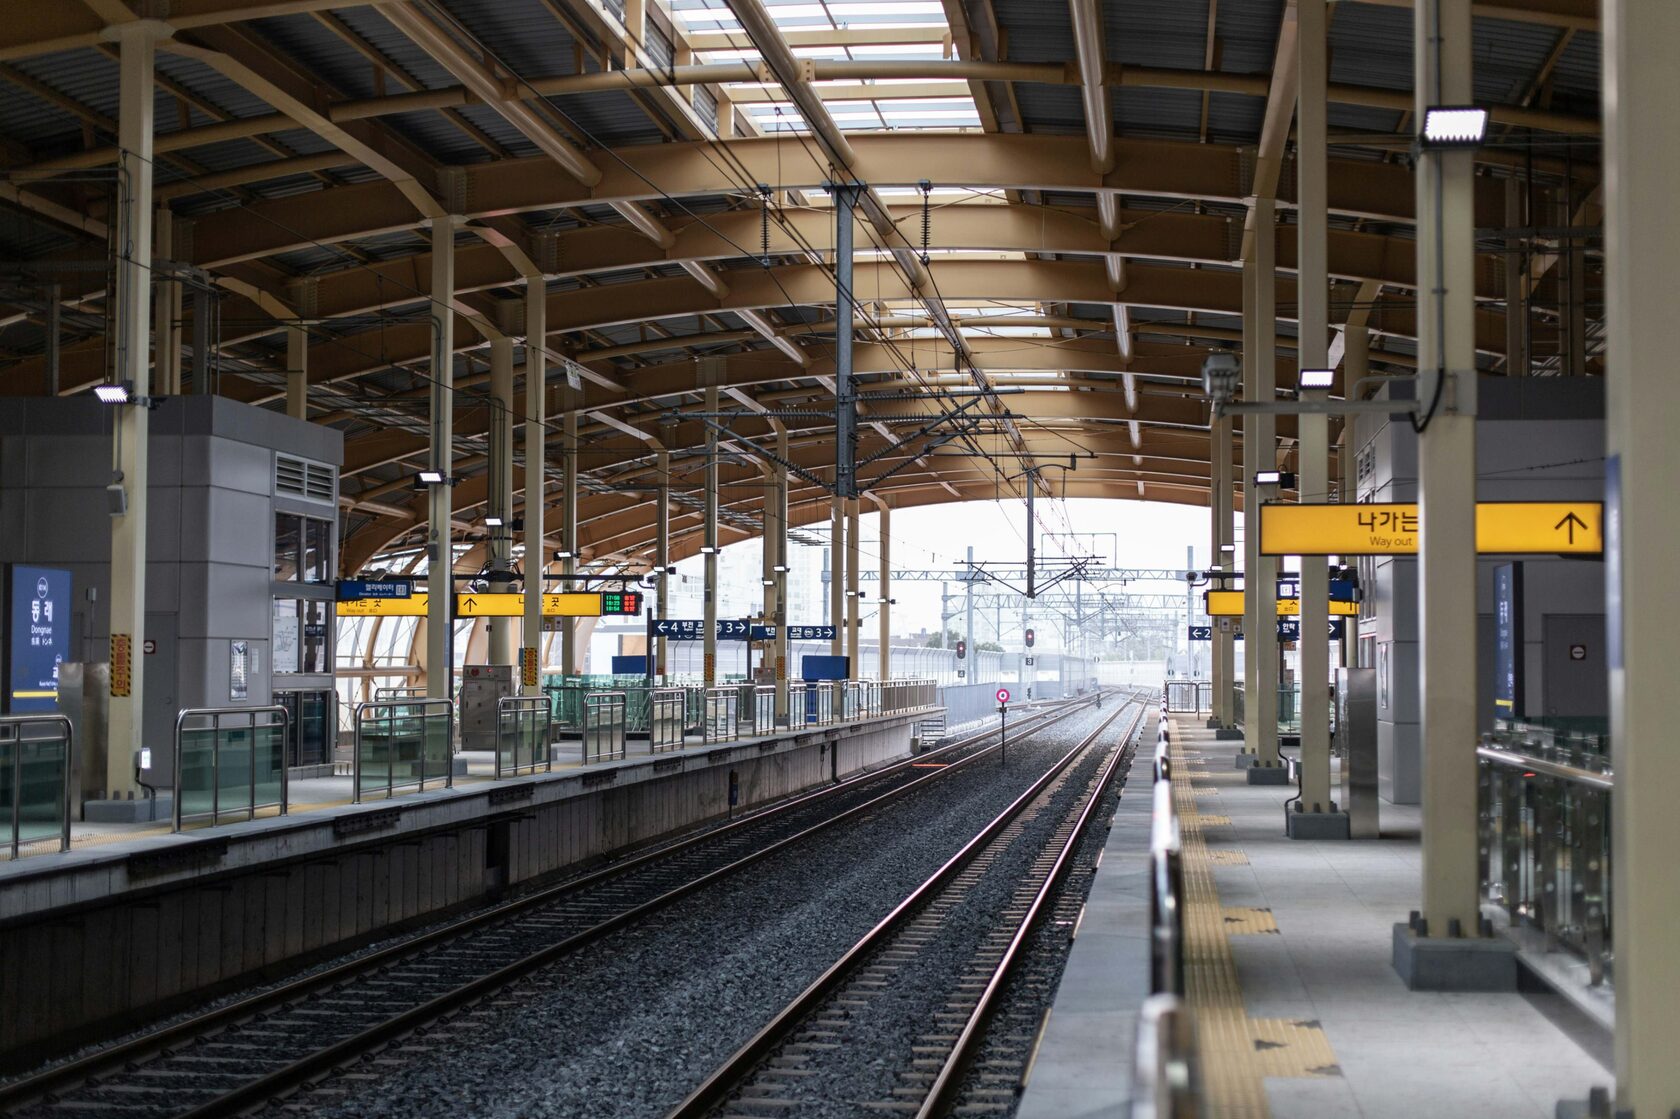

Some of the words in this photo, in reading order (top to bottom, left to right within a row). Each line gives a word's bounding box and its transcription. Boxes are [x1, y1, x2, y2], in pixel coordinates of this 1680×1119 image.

[1358, 512, 1418, 532] 나가는
[1370, 536, 1391, 548] Way
[1394, 538, 1412, 546] out
[31, 600, 52, 622] 동래
[31, 625, 52, 636] Dongnae
[671, 622, 678, 632] 4
[726, 623, 732, 632] 3
[816, 628, 821, 637] 3
[1204, 629, 1211, 638] 2
